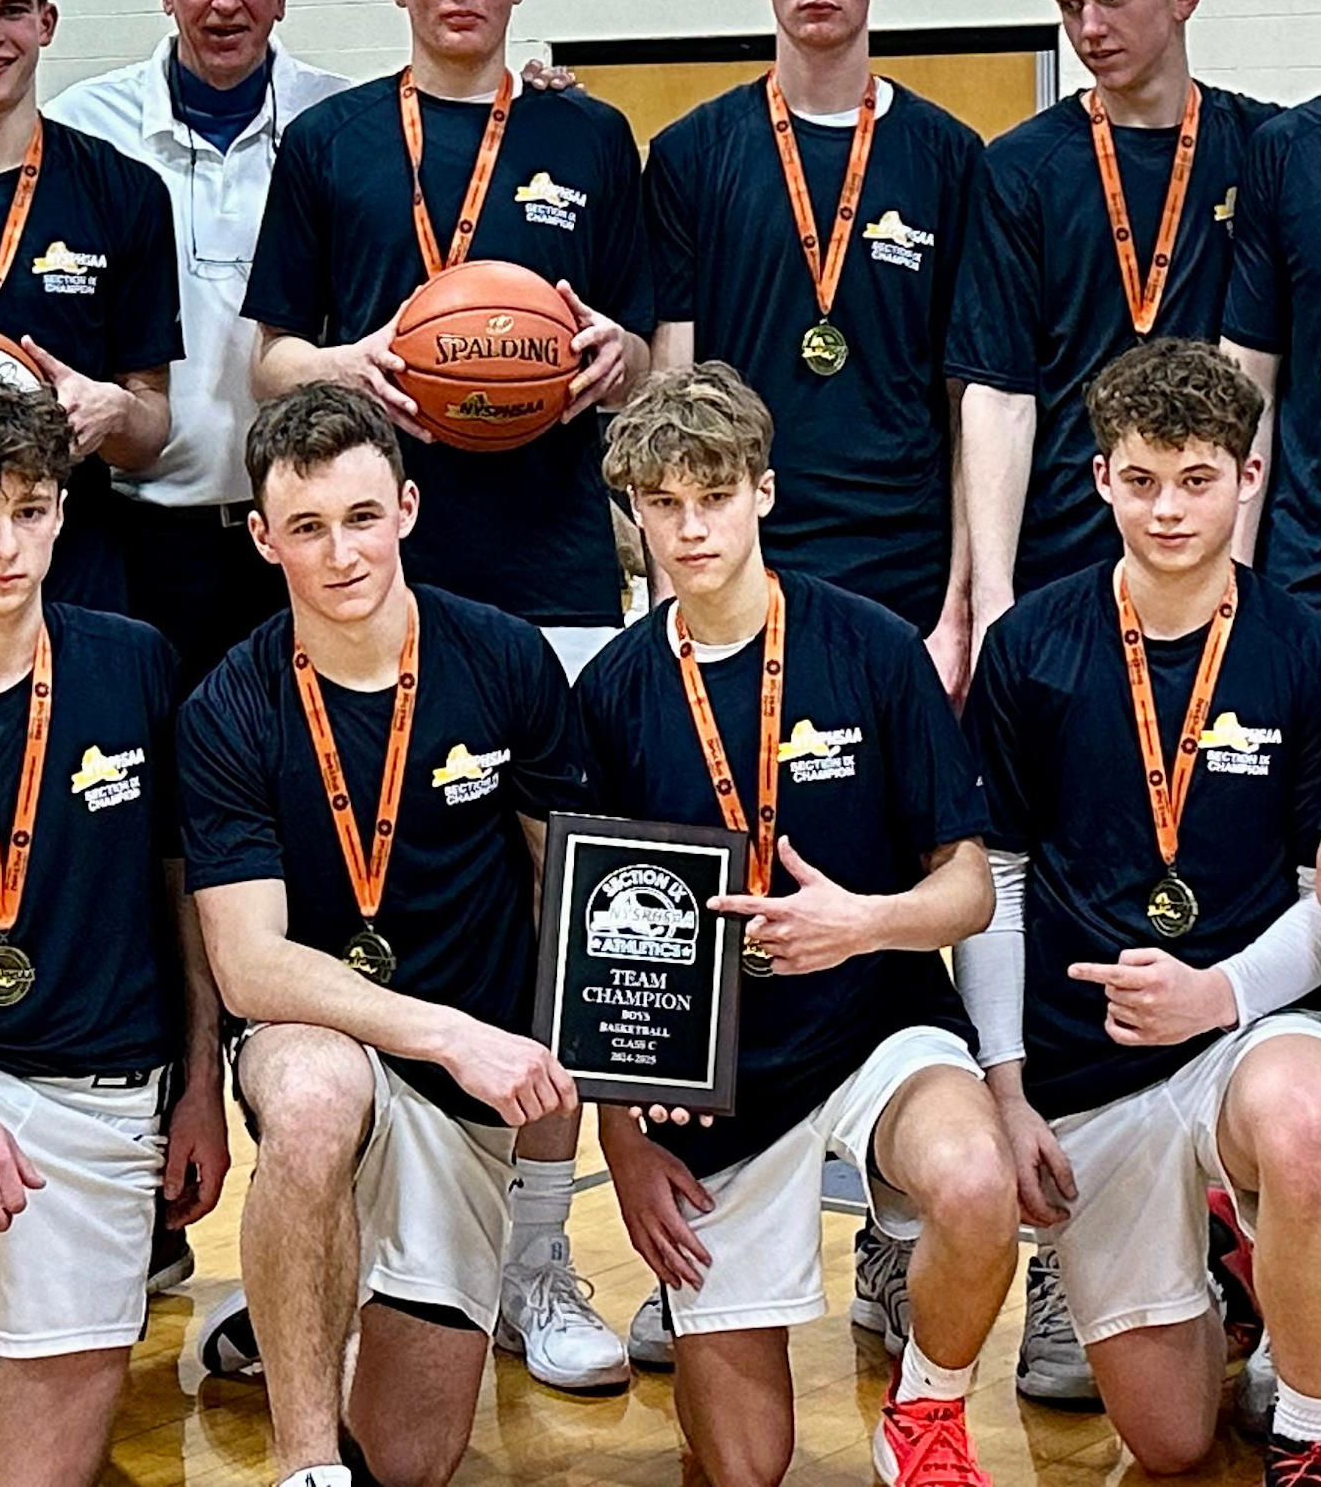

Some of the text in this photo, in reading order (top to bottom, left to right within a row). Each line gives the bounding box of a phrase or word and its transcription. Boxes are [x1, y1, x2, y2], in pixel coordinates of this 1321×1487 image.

[435, 334, 560, 367] SPALDING
[602, 870, 670, 898] SECTION
[601, 938, 681, 957] ATHLETICS
[610, 968, 667, 989] TEAM
[582, 986, 692, 1011] CHAMPION
[621, 1009, 650, 1021] BOYS
[599, 1021, 671, 1037] BASKETBALL
[611, 1038, 657, 1050] CLASS C
